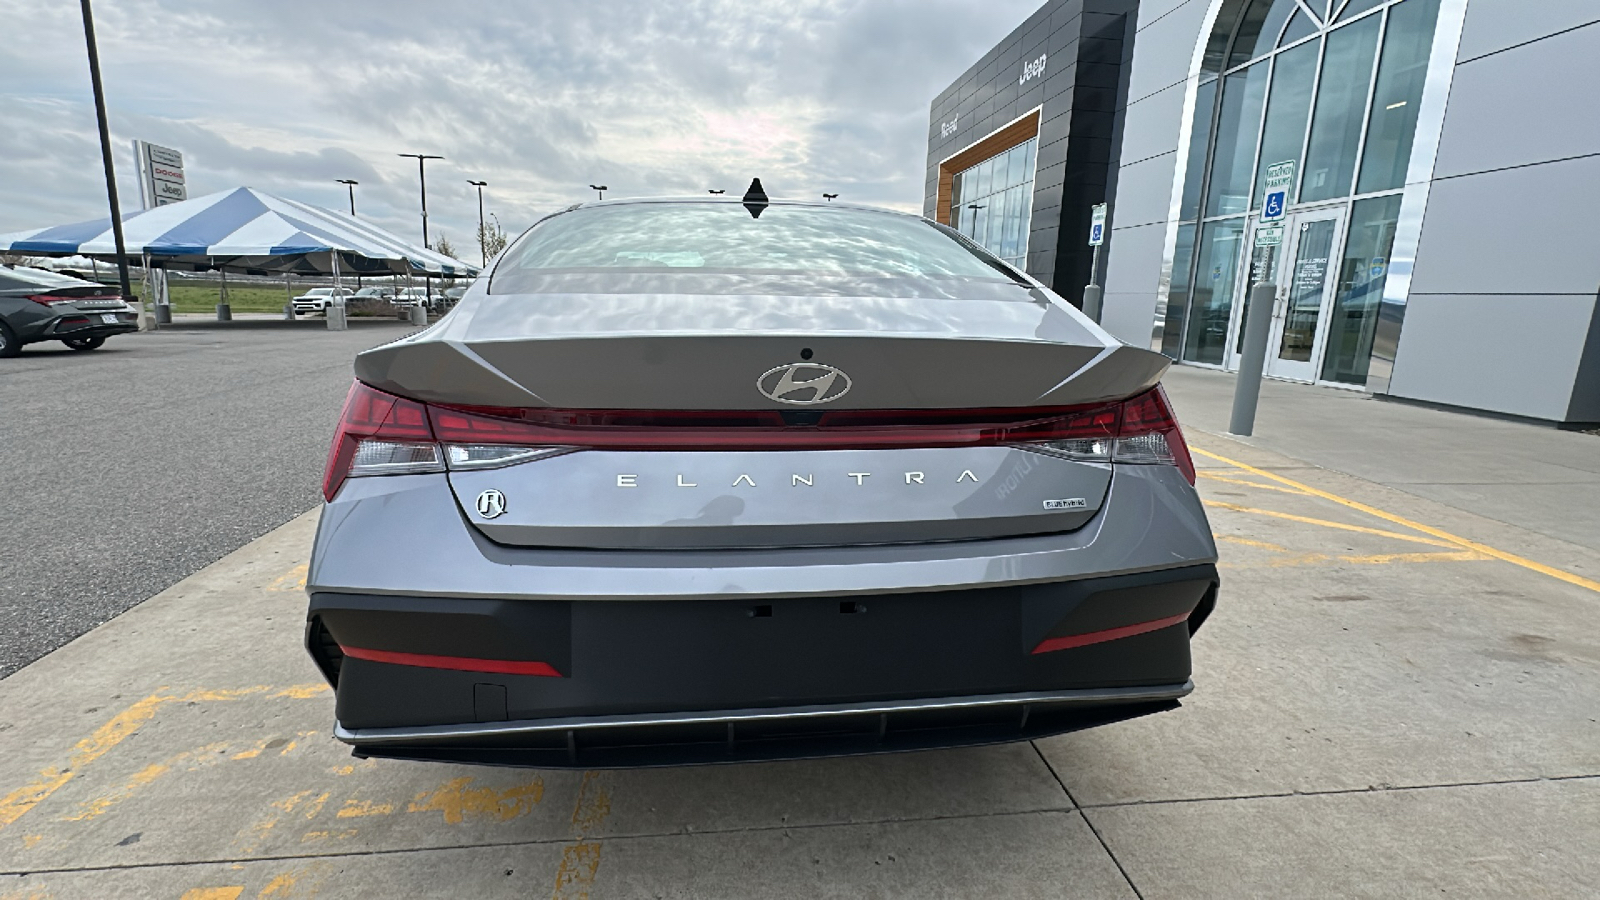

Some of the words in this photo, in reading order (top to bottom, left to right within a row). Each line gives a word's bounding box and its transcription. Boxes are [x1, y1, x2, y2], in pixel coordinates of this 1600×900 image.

[1020, 54, 1047, 86] Jeep
[154, 168, 183, 179] DODGE
[162, 183, 182, 197] Jeep
[616, 469, 979, 488] ELANTRA
